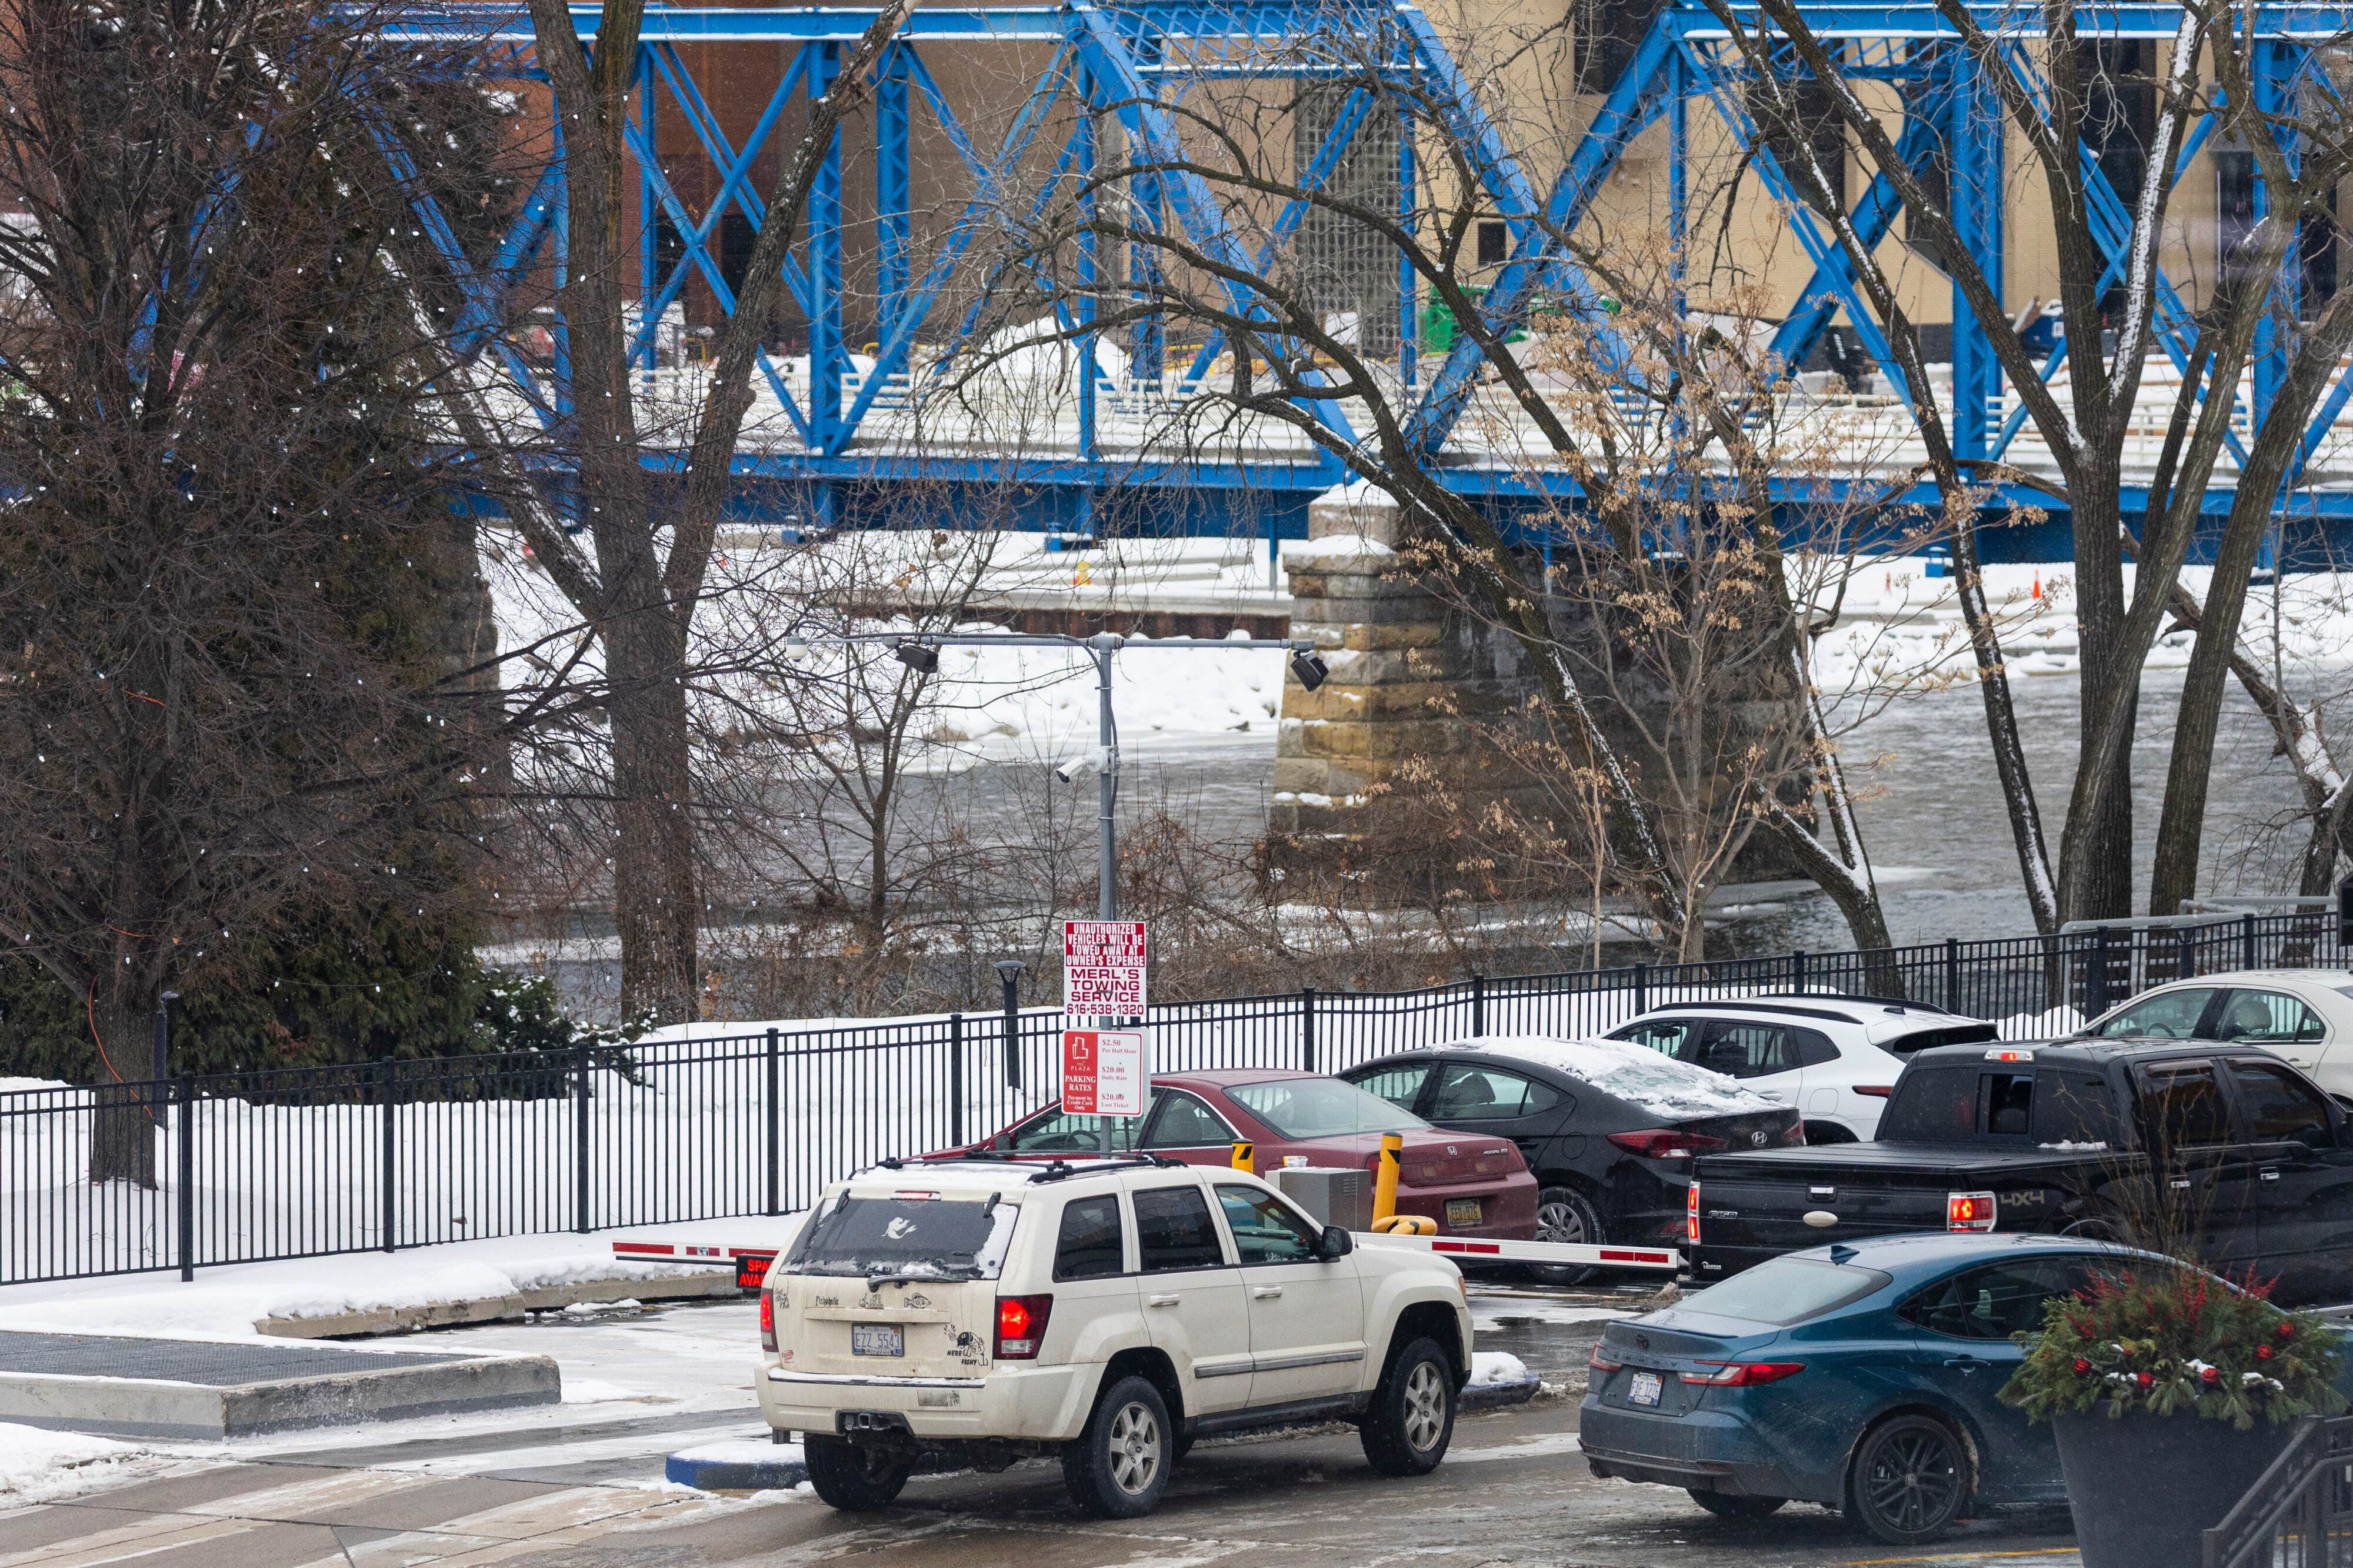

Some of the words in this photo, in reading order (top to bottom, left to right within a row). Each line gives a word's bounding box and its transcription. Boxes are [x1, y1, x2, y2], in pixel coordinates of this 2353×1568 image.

[1074, 923, 1136, 935] UNAUTHORIZED
[1068, 934, 1106, 945] VEHICLES
[1109, 935, 1129, 945] WILL
[1132, 935, 1143, 946] BE
[1072, 945, 1100, 955] TOWED
[1103, 945, 1126, 956] AWAY
[1128, 945, 1138, 956] AT
[1066, 955, 1104, 966] OWNER'S
[1106, 955, 1144, 966] EXPENSE
[1071, 969, 1139, 979] MERL'S
[1071, 980, 1139, 990] TOWING
[1071, 992, 1139, 1002] SERVICE
[748, 1259, 772, 1272] SPA
[855, 1333, 871, 1347] EZZ
[878, 1333, 899, 1348] 5543
